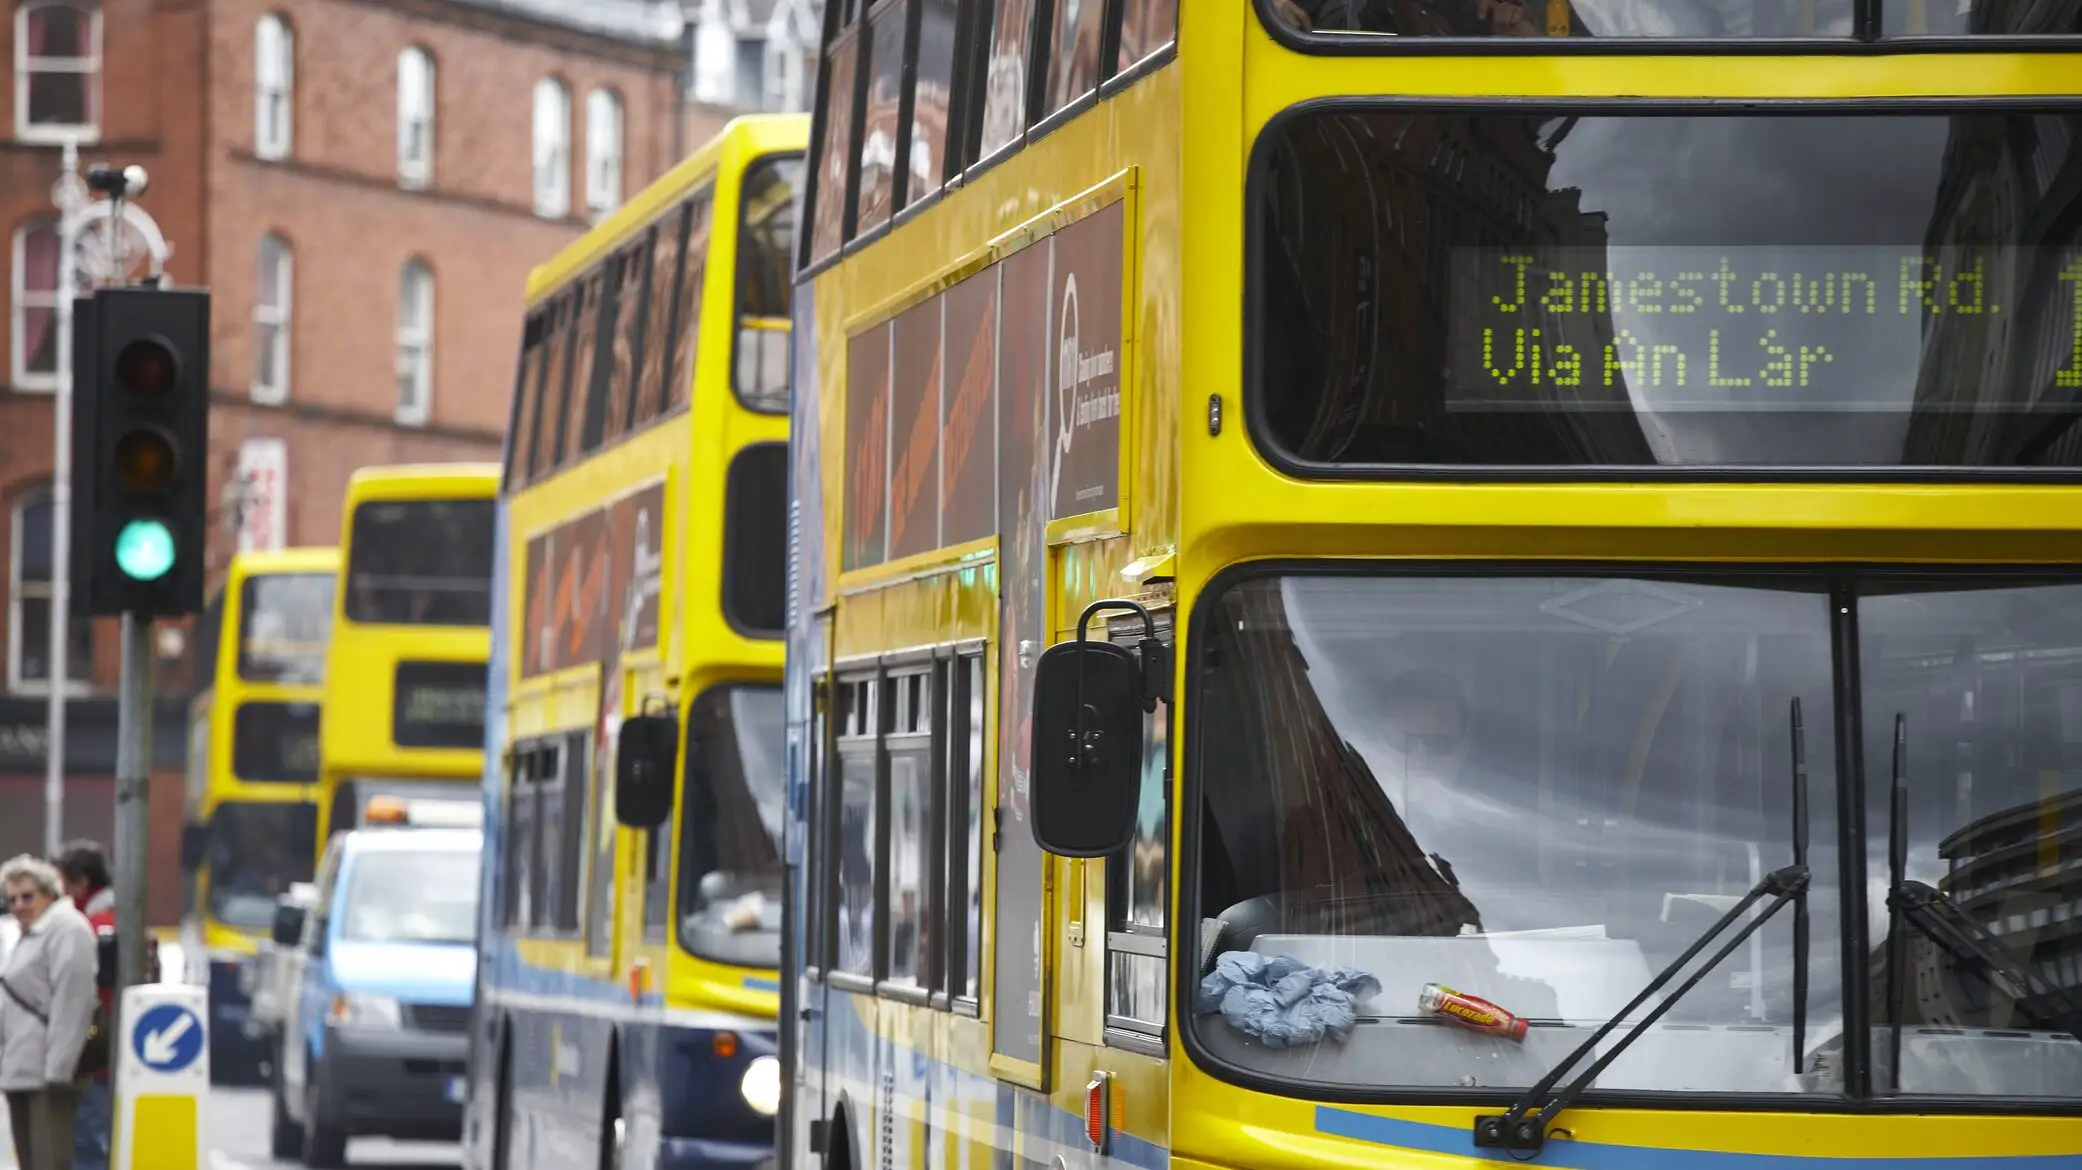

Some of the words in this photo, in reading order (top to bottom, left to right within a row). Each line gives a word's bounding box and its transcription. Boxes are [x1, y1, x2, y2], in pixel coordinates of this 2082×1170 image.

[1492, 256, 1876, 314] Jamestown
[1900, 256, 1999, 314] Rd.
[1483, 328, 1581, 386] Via
[1604, 328, 1686, 386] An
[1443, 1000, 1496, 1025] Lucozade
